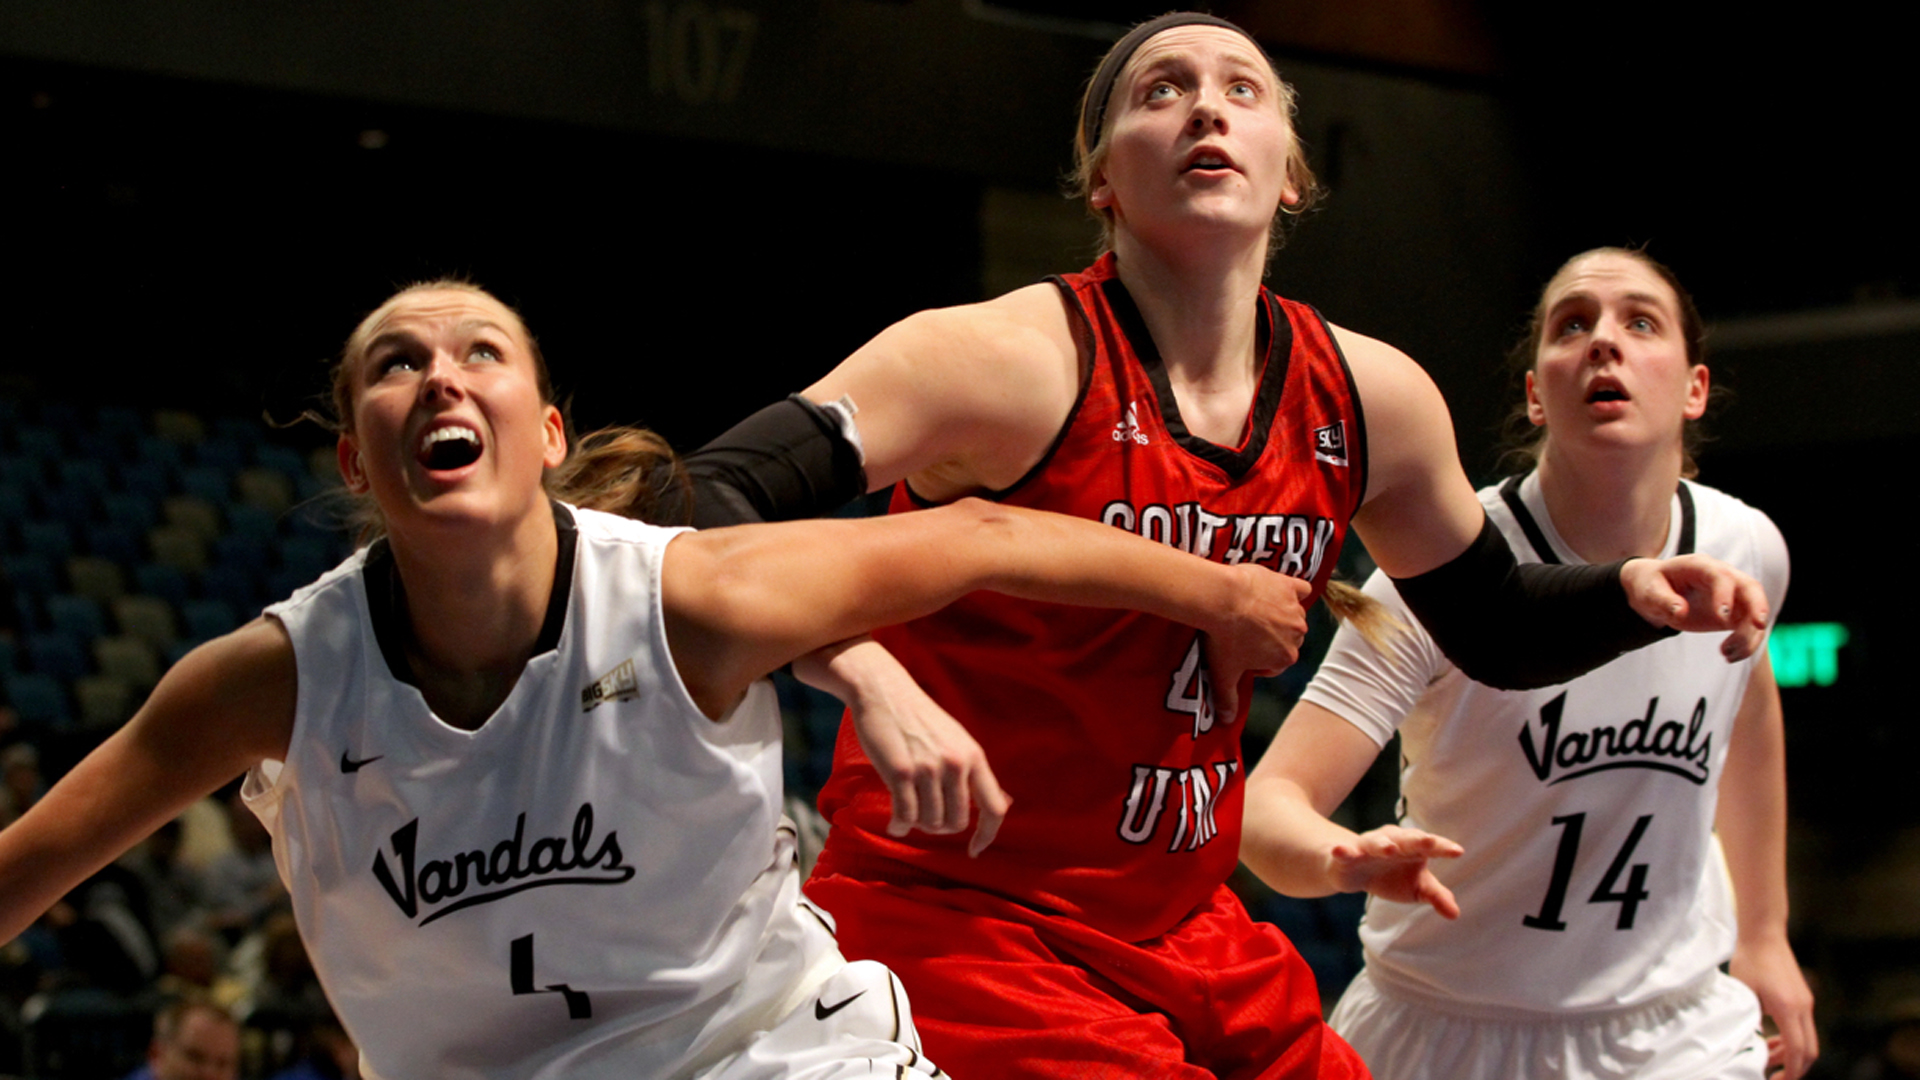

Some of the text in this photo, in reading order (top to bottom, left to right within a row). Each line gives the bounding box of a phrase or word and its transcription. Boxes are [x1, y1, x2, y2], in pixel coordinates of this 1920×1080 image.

[644, 3, 758, 103] 107
[1112, 429, 1149, 445] adas
[1518, 690, 1711, 786] Vandals
[372, 802, 635, 926] Vandals
[1522, 812, 1654, 931] 14
